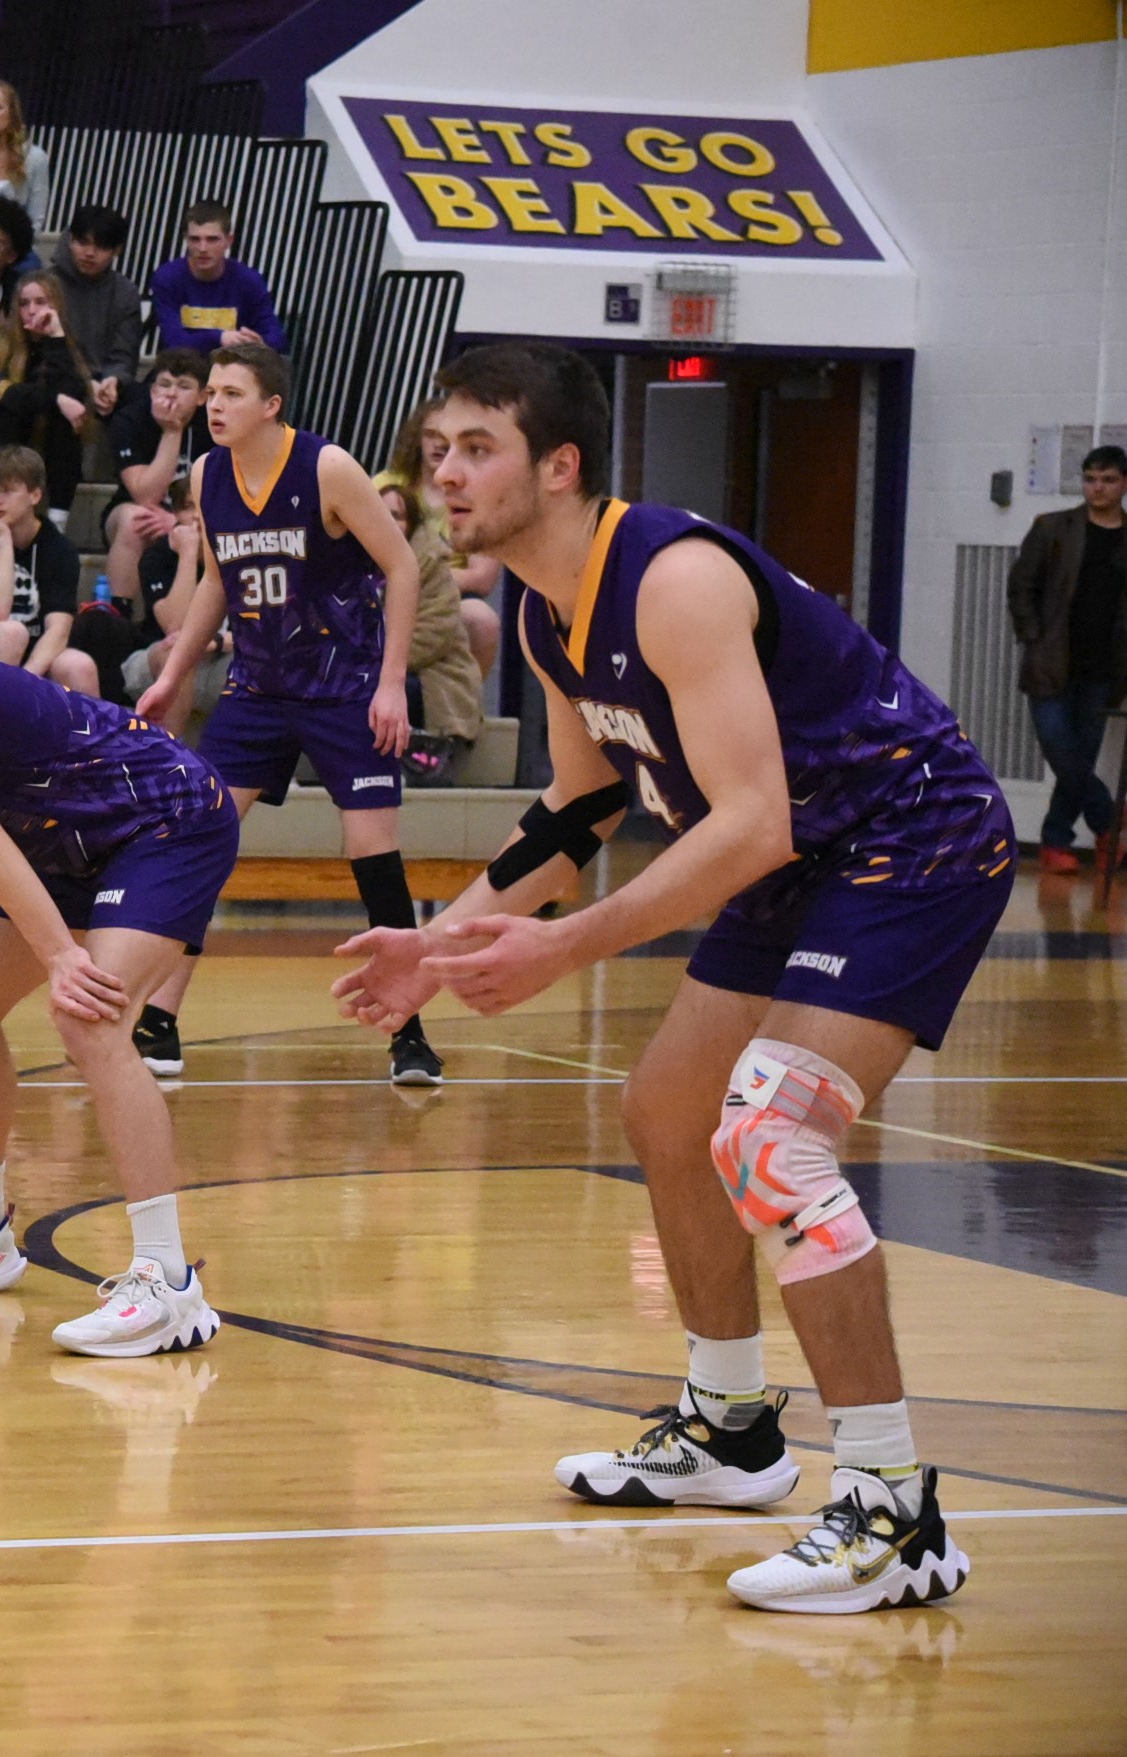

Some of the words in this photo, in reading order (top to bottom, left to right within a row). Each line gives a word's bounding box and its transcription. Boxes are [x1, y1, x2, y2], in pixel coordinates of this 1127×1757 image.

[383, 114, 593, 169] LETS
[625, 127, 776, 178] GO
[404, 172, 845, 247] BEARS!
[215, 528, 306, 565] JACKSON
[240, 565, 288, 607] 30
[352, 775, 394, 791] JACKSON
[637, 762, 675, 827] 4
